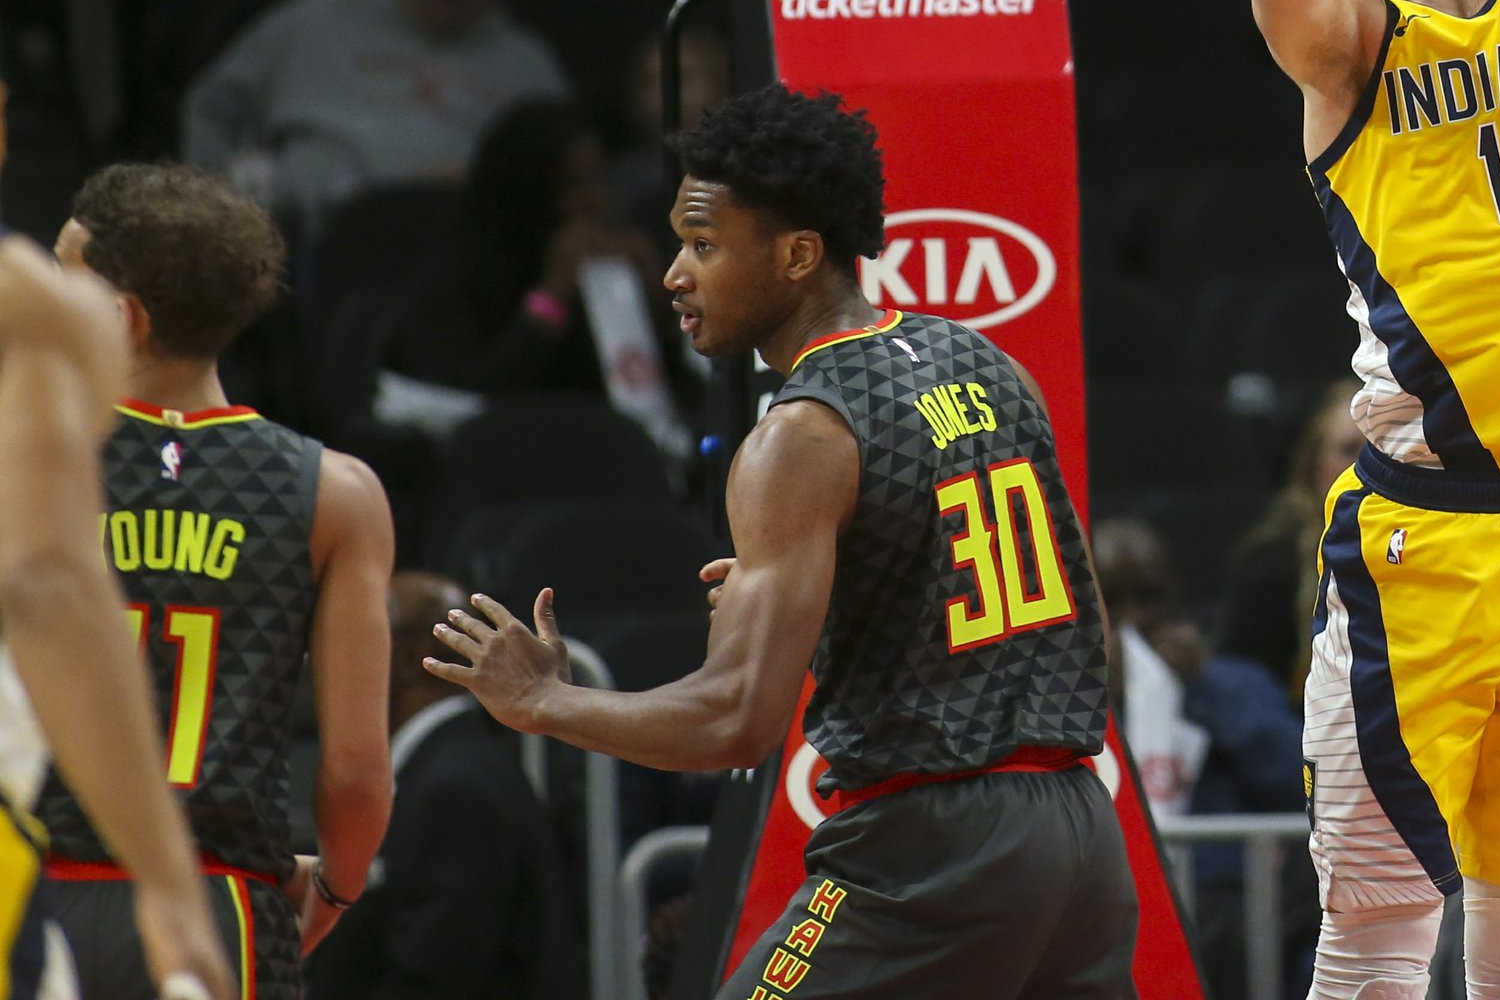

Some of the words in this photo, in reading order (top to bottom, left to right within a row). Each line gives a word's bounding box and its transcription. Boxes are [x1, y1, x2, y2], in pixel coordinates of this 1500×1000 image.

[861, 237, 1017, 305] KIA
[914, 382, 997, 450] JONES
[935, 456, 1078, 654] 30
[122, 602, 221, 791] 1
